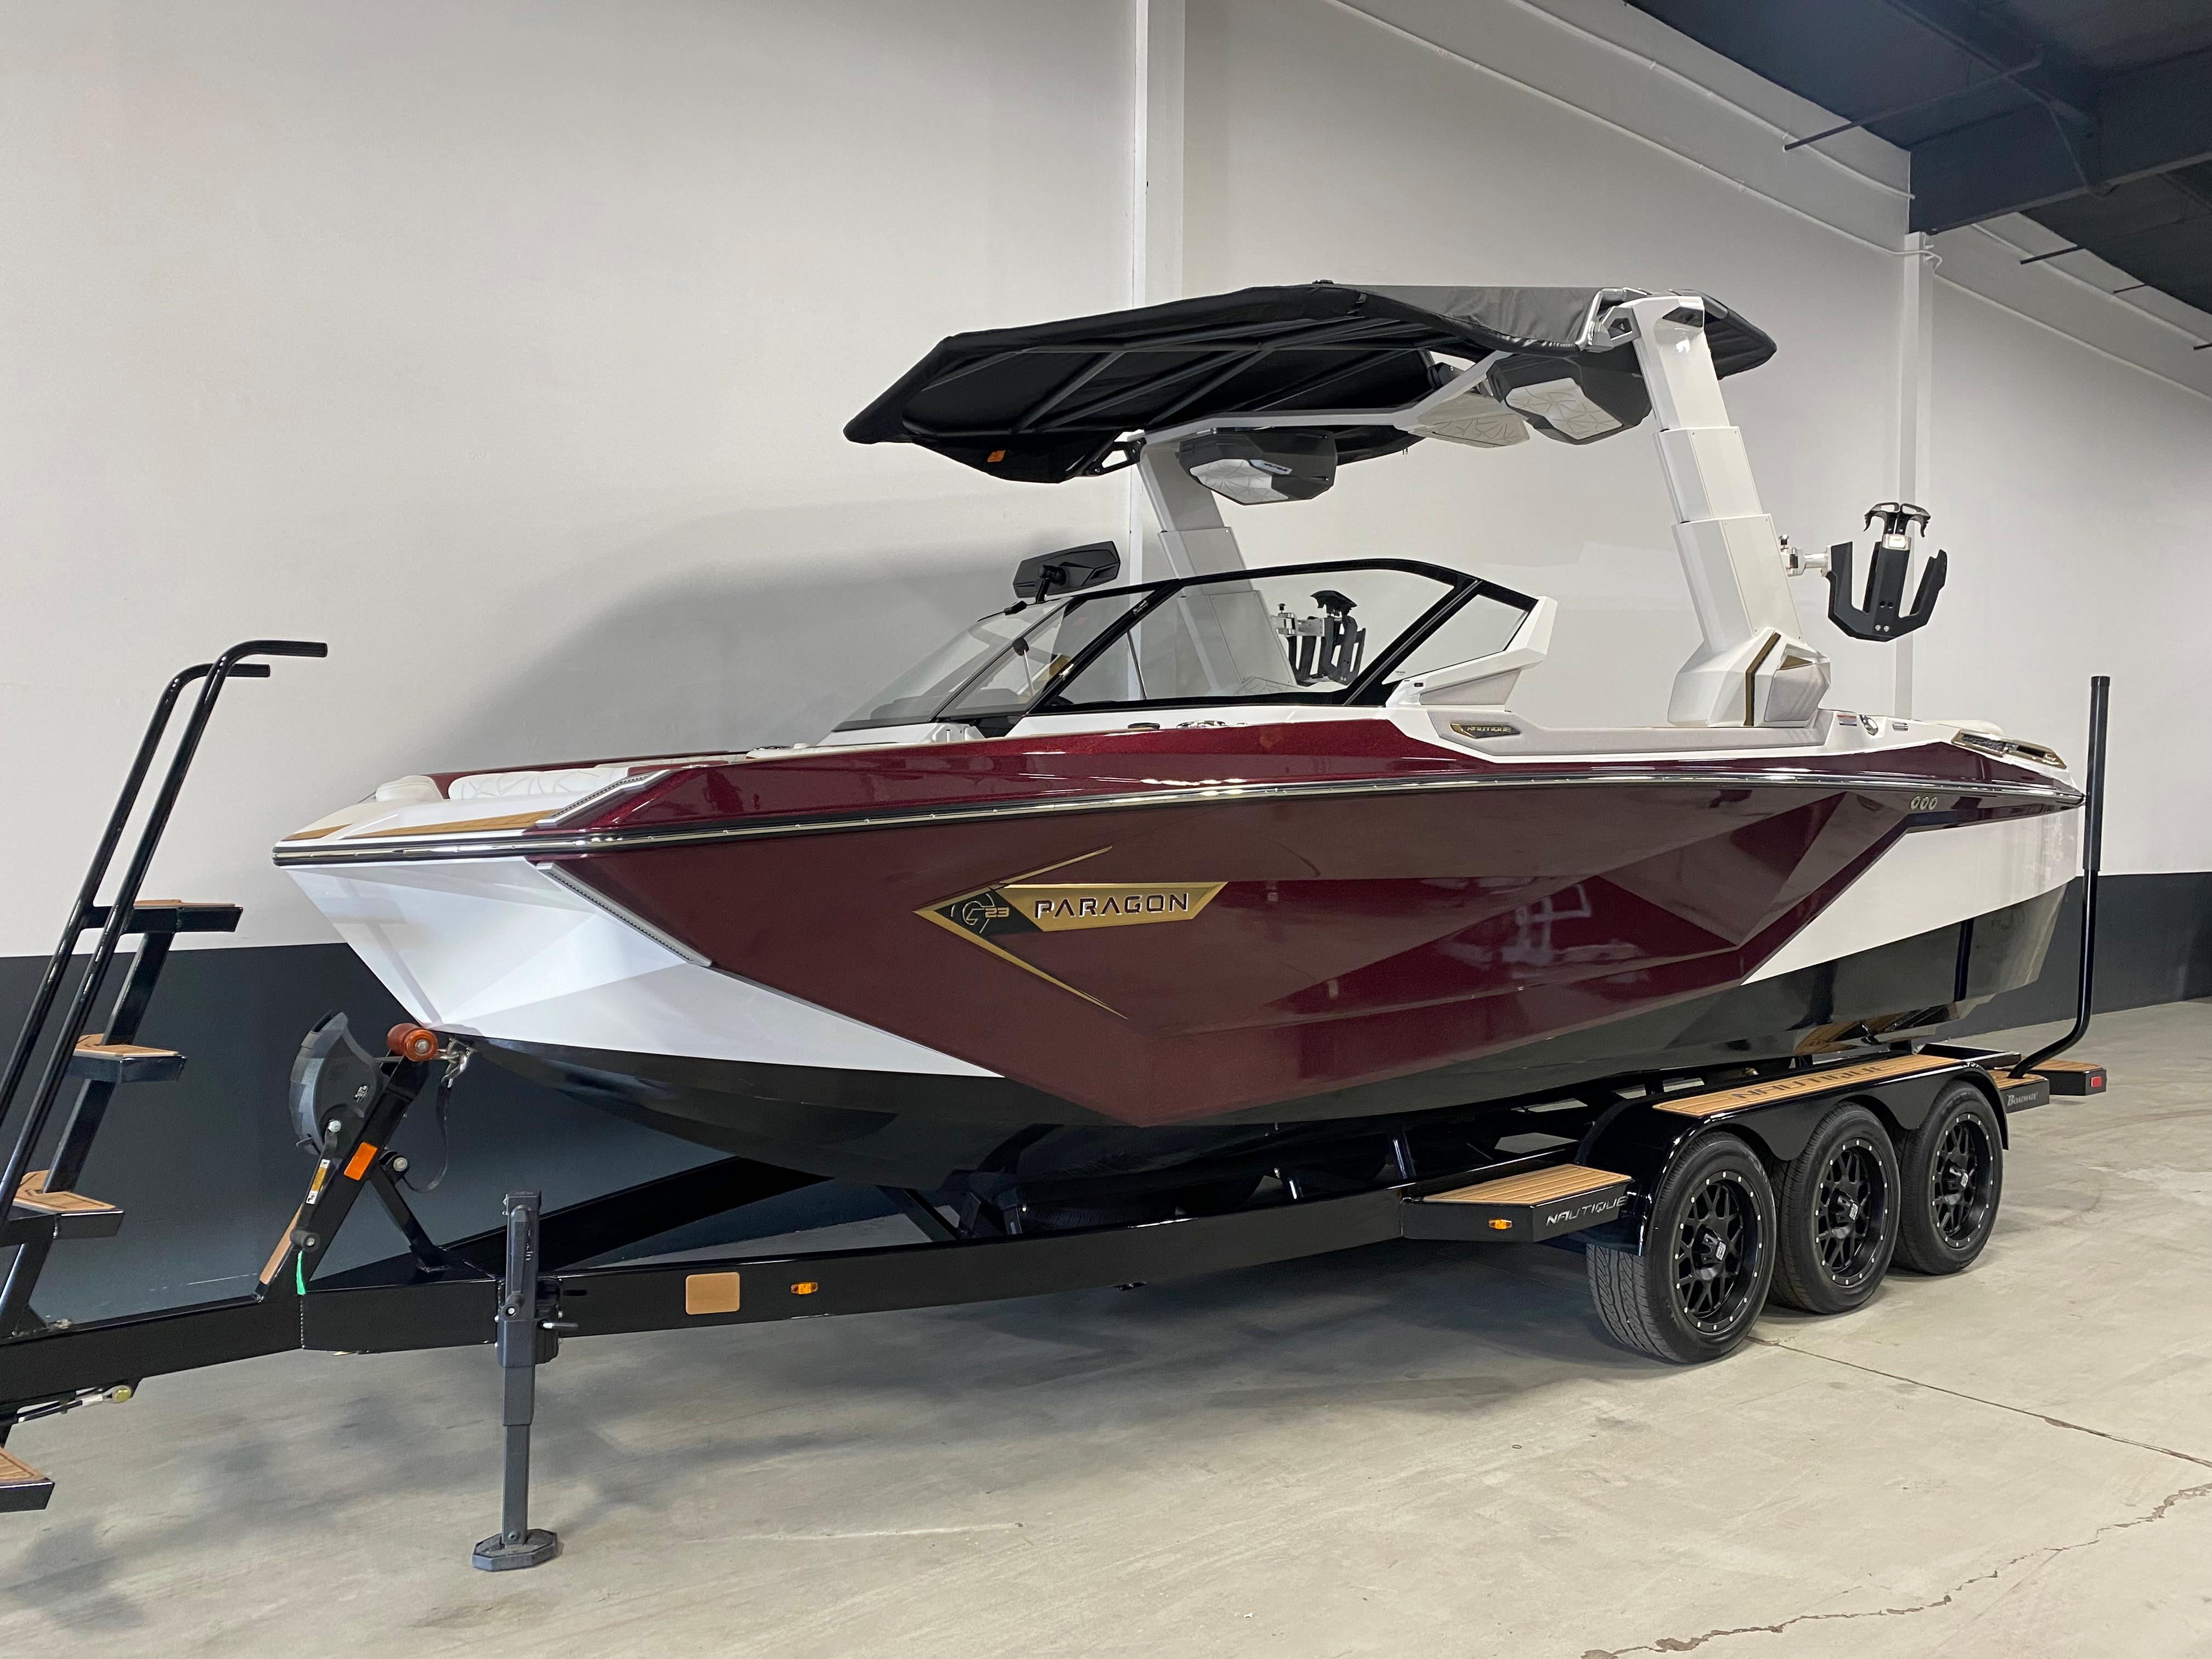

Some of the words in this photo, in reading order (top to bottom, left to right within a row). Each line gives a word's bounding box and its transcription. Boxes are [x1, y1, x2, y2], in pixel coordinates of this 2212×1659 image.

[1034, 893, 1189, 919] PARAGON
[1732, 1063, 1892, 1099] NAUTIQUE
[1546, 1195, 1628, 1226] NAUTIQUE
